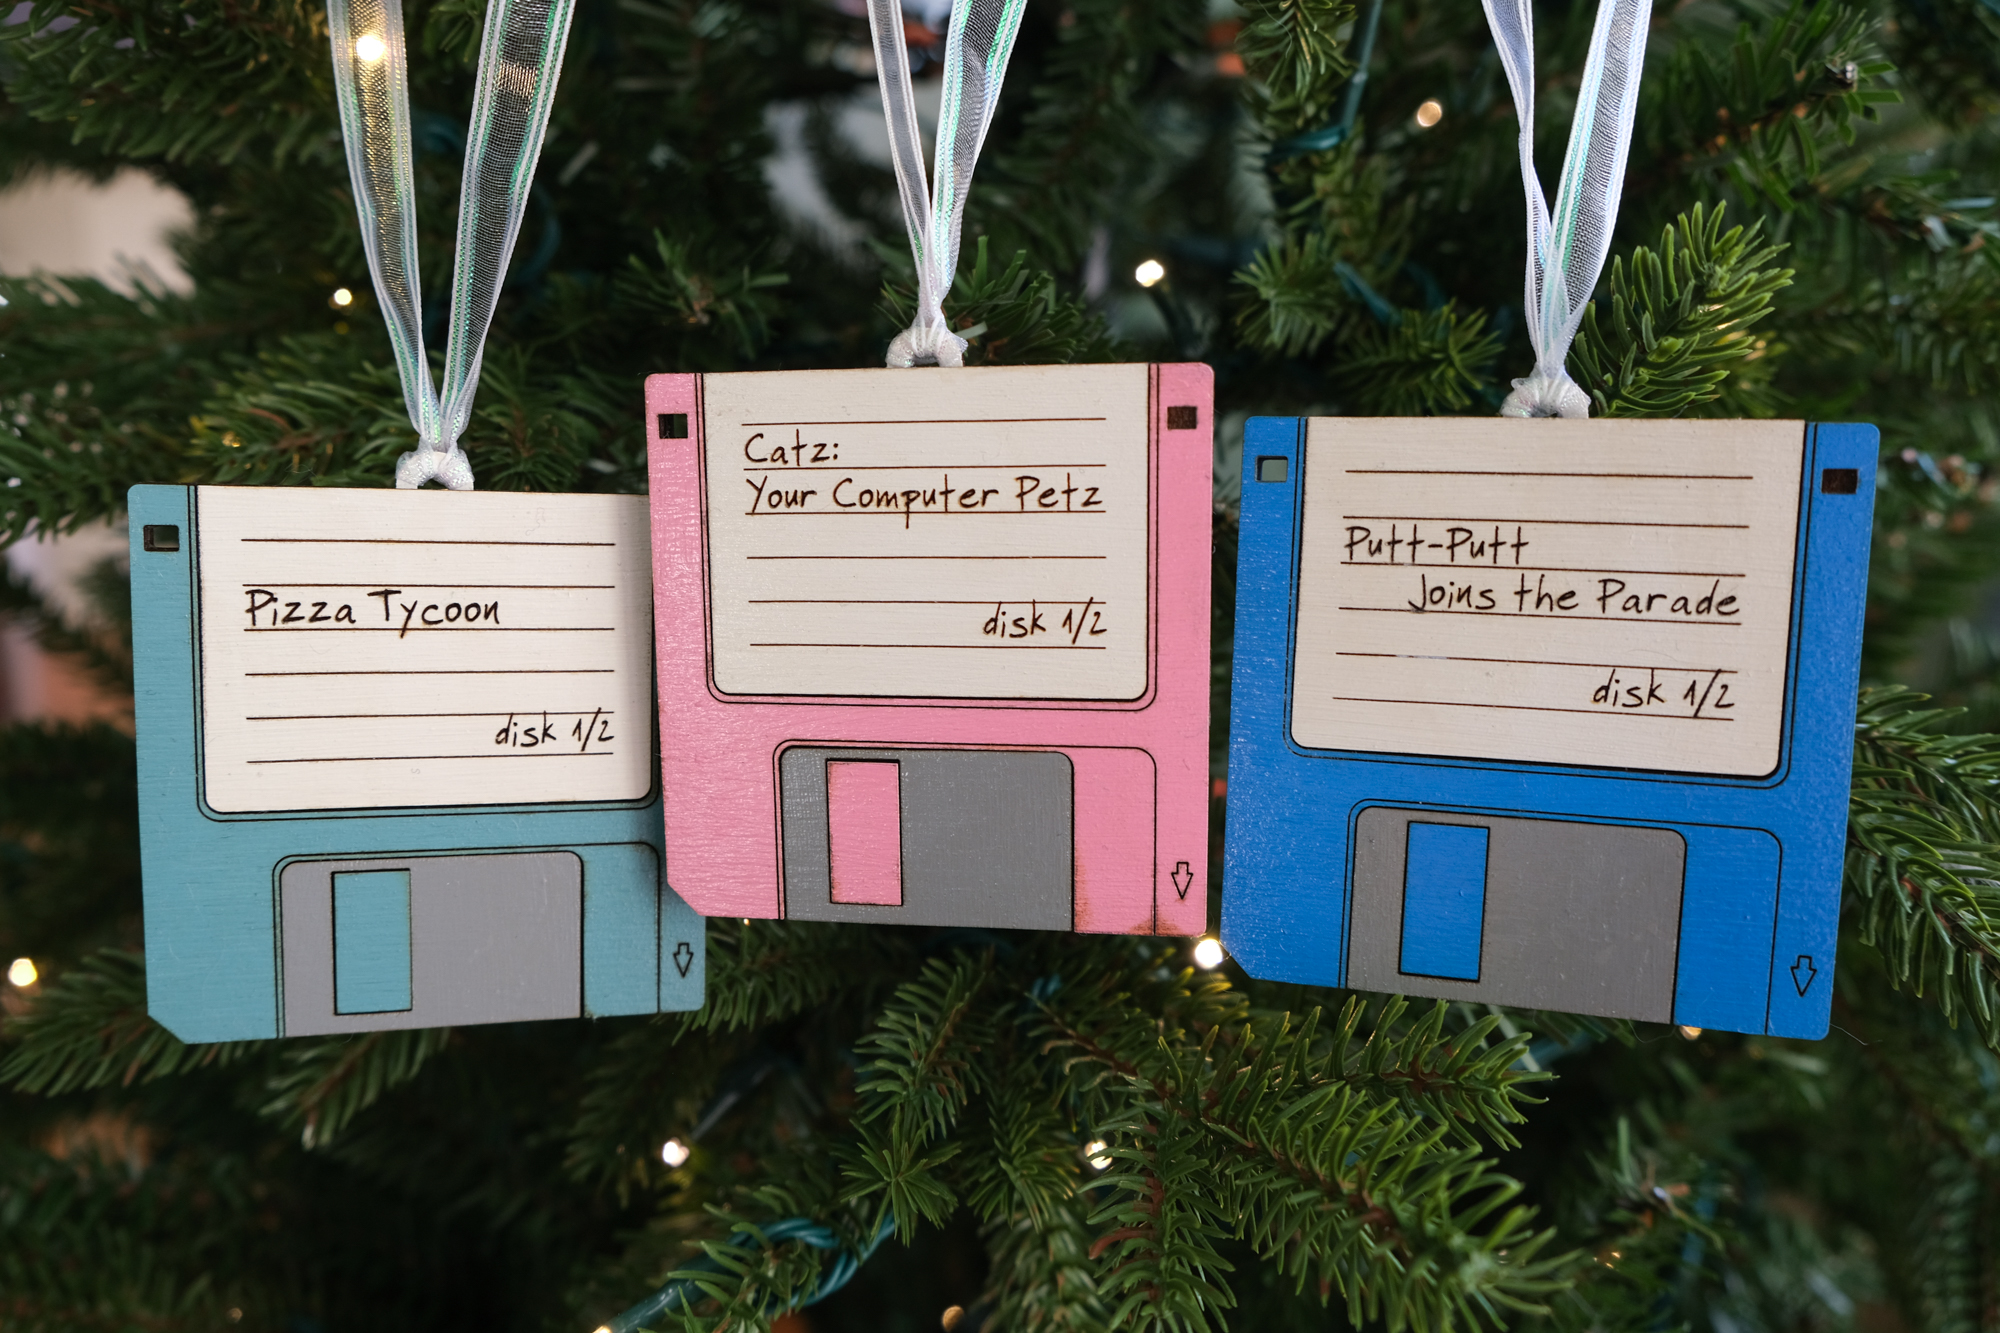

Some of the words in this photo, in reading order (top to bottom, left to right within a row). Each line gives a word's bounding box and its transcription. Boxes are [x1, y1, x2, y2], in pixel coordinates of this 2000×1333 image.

[744, 428, 838, 466] Catz:
[746, 475, 817, 513] Your
[832, 474, 999, 529] Computer
[1014, 472, 1103, 512] Petz
[1344, 524, 1529, 564] Putt-Putt
[245, 588, 356, 626] Pizza
[367, 588, 500, 639] Tycoon
[1408, 573, 1496, 613] Joins
[1513, 573, 1579, 613] the
[1598, 578, 1740, 616] Parade
[983, 599, 1046, 638] disk
[1061, 597, 1107, 644] 1/2
[1592, 667, 1665, 708] disk
[1682, 669, 1735, 718] 1/2
[495, 710, 556, 748] disk
[571, 707, 614, 752] 1/2
